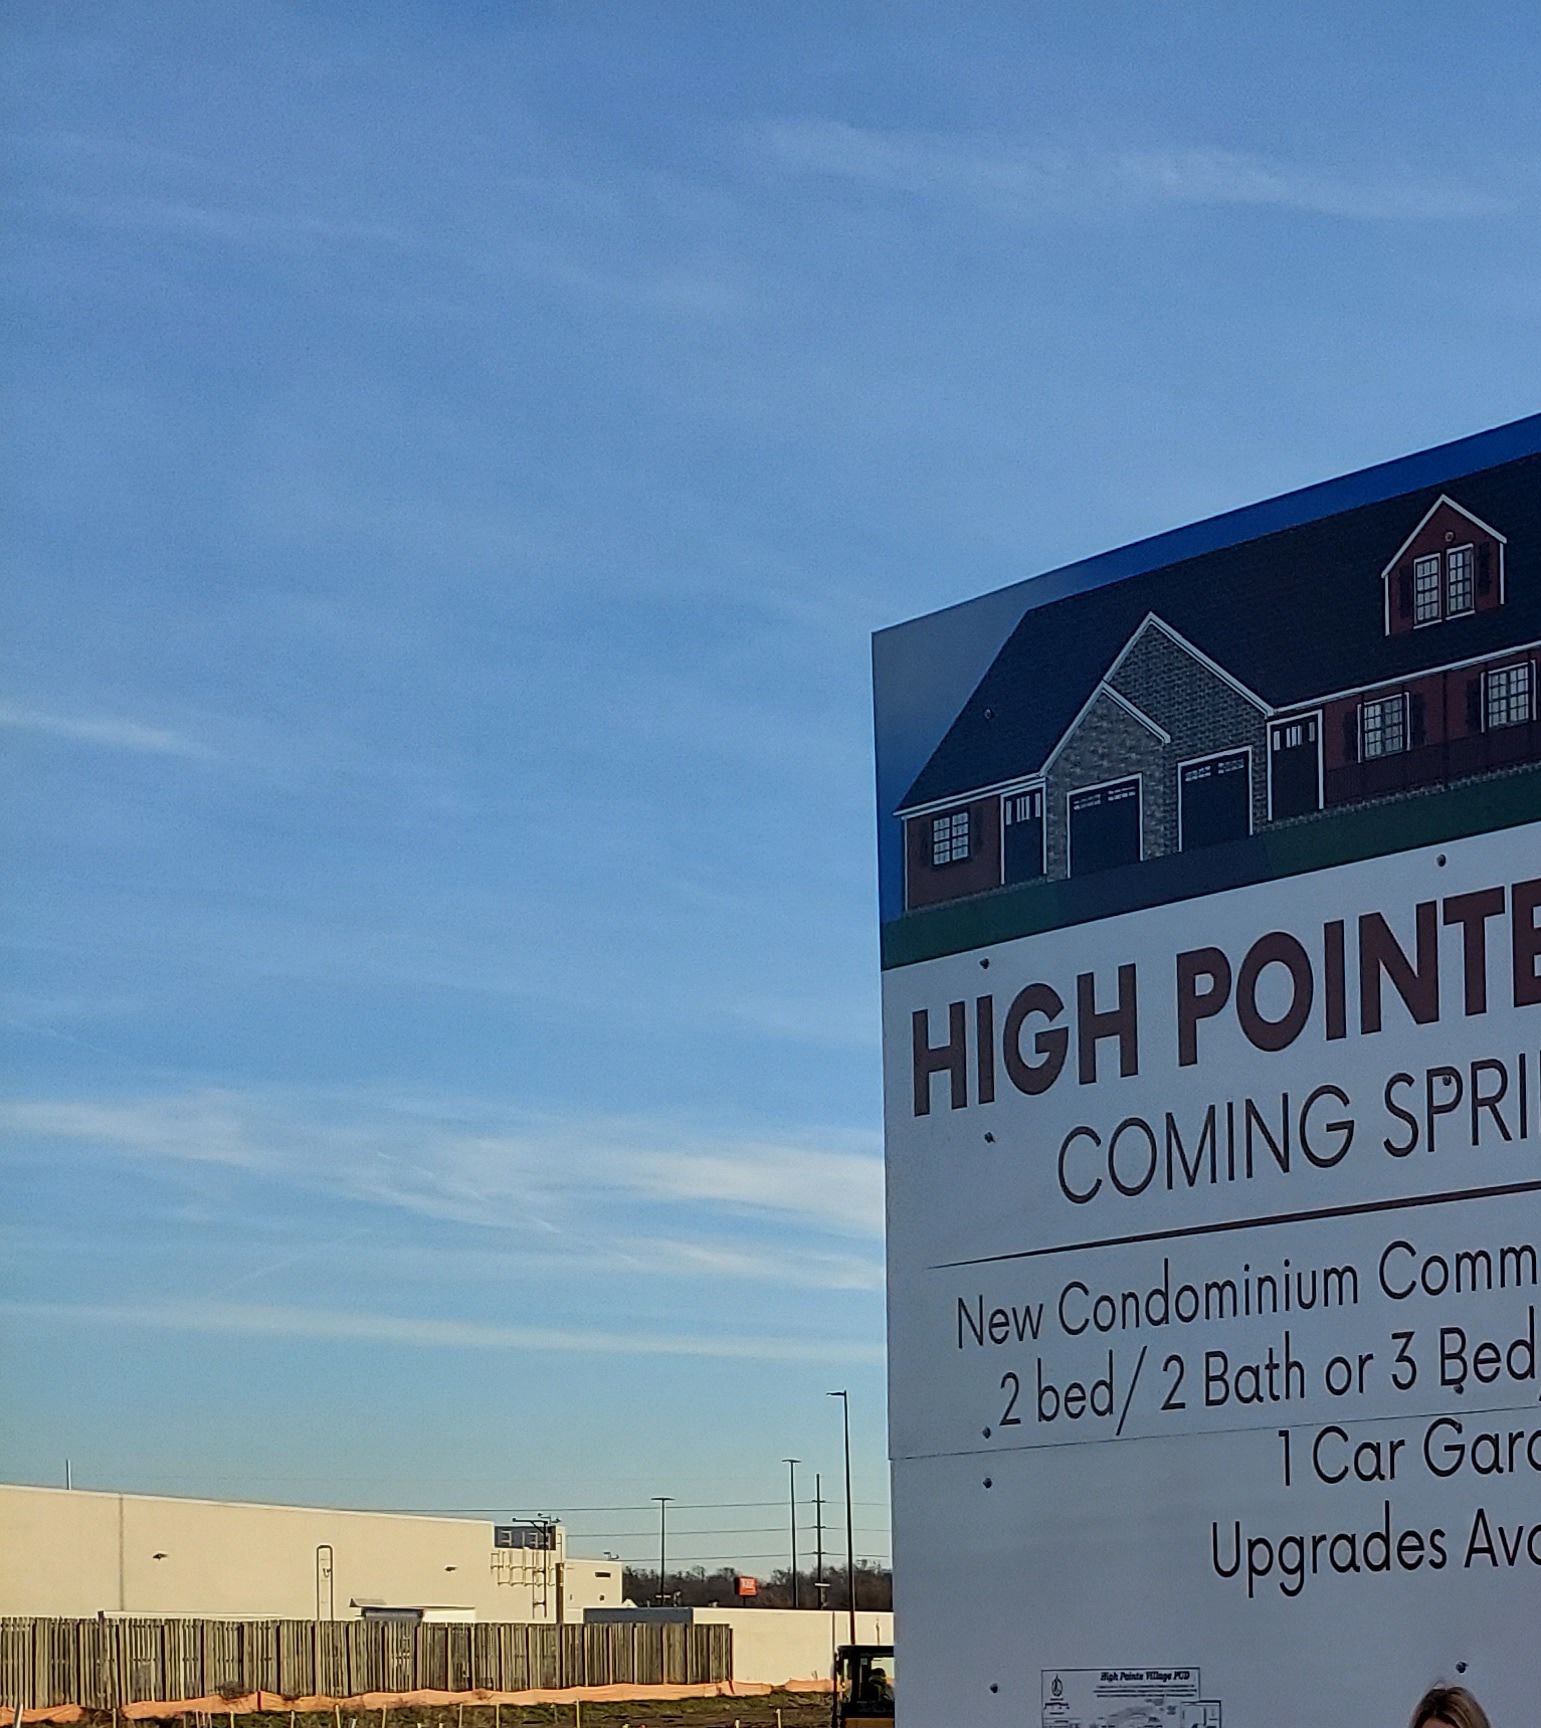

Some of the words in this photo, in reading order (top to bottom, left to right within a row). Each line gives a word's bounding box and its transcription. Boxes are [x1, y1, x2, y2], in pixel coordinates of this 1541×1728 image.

[911, 965, 1139, 1117] HIGH
[1058, 1084, 1355, 1206] COMING
[957, 1295, 1043, 1349] New
[1058, 1258, 1359, 1337] Condominium
[999, 1375, 1023, 1426] 2
[1160, 1354, 1188, 1411] 2
[1203, 1330, 1306, 1407] Bath
[1325, 1354, 1376, 1397] or
[1390, 1330, 1418, 1390] 3
[1277, 1429, 1292, 1486] 1
[1312, 1427, 1406, 1483] Car
[1211, 1499, 1448, 1598] Upgrades
